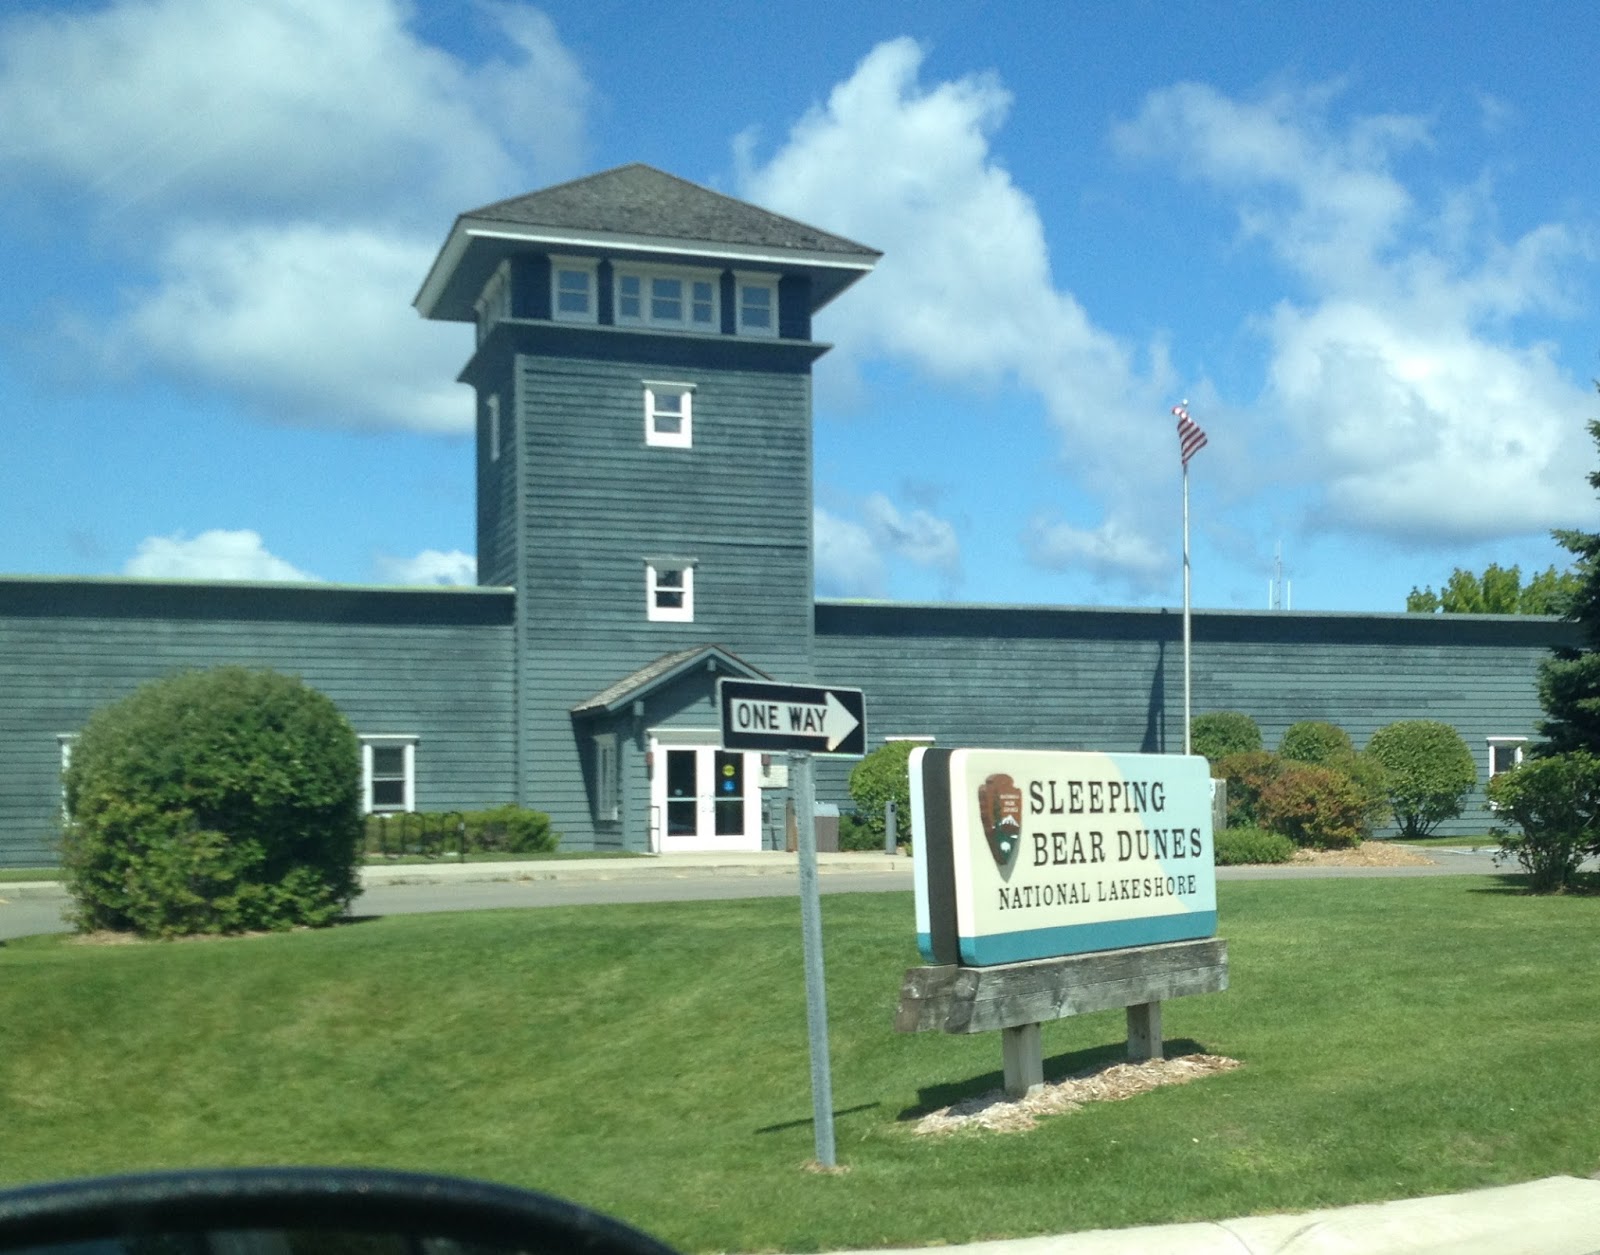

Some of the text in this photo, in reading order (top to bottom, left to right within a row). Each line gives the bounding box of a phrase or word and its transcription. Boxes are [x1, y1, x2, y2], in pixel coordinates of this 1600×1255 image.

[738, 703, 827, 732] ONE WAY
[1029, 780, 1166, 814] SLEEPING
[1032, 827, 1202, 866] BEAR DUNES
[999, 875, 1197, 910] NATIONAL LAKESHORE
